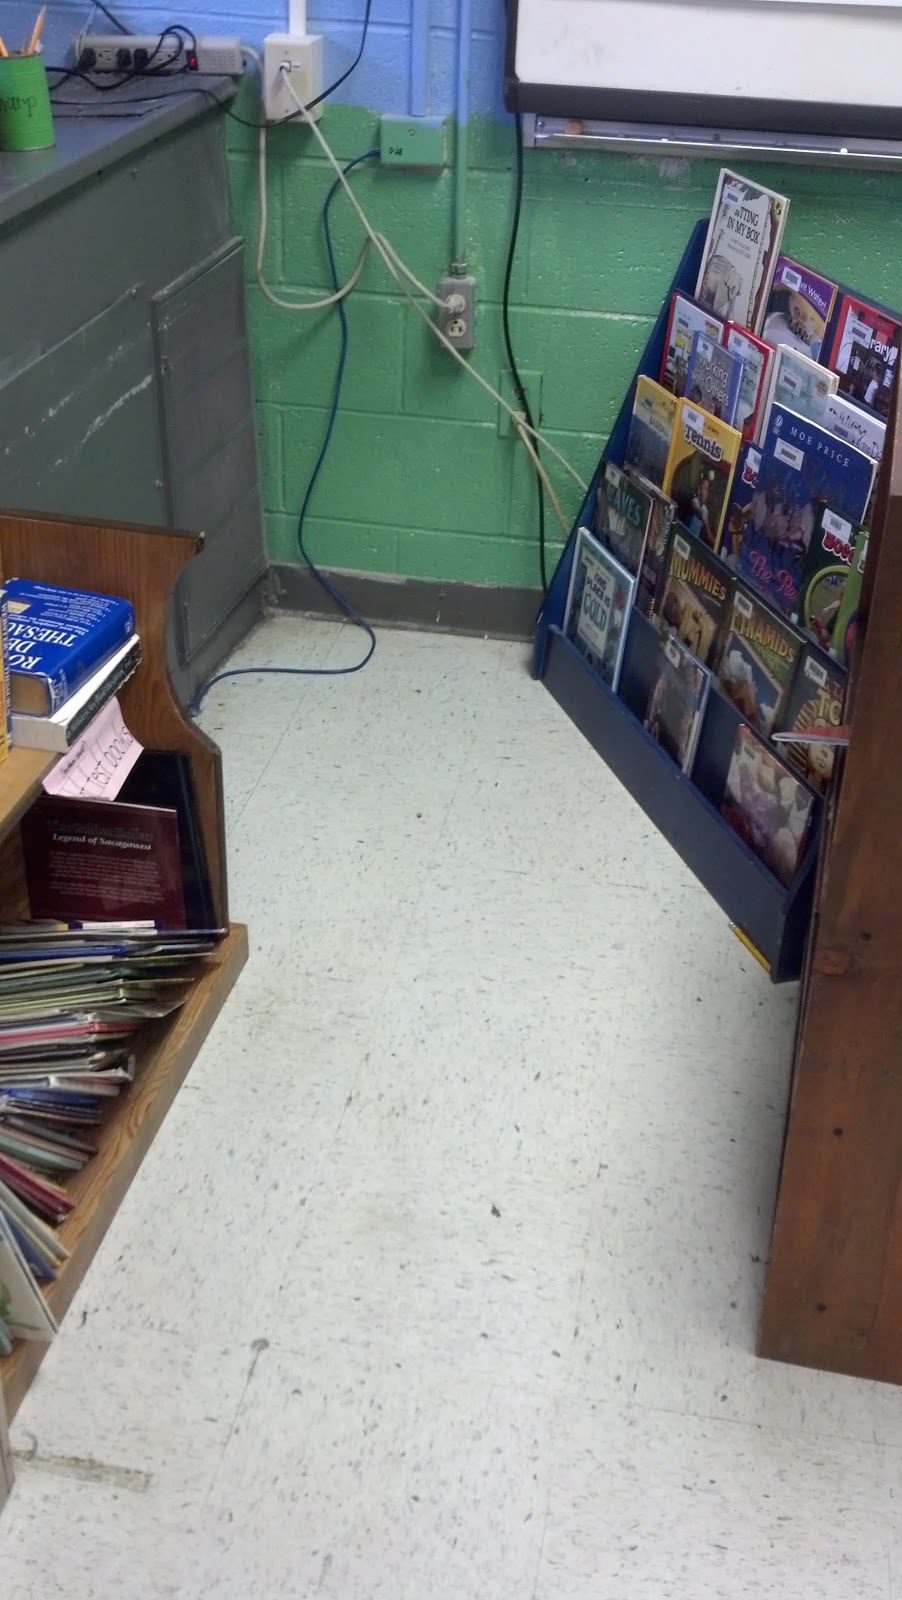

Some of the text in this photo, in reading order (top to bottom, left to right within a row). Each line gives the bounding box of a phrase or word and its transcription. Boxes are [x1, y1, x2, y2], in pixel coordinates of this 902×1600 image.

[727, 216, 760, 244] IN MY BOX
[684, 424, 723, 460] Tennis
[790, 427, 813, 445] MOE
[817, 442, 850, 468] PRICE
[670, 551, 727, 600] MUMMIES
[583, 592, 607, 632] COLD
[52, 832, 86, 844] Legend
[87, 836, 98, 847] of
